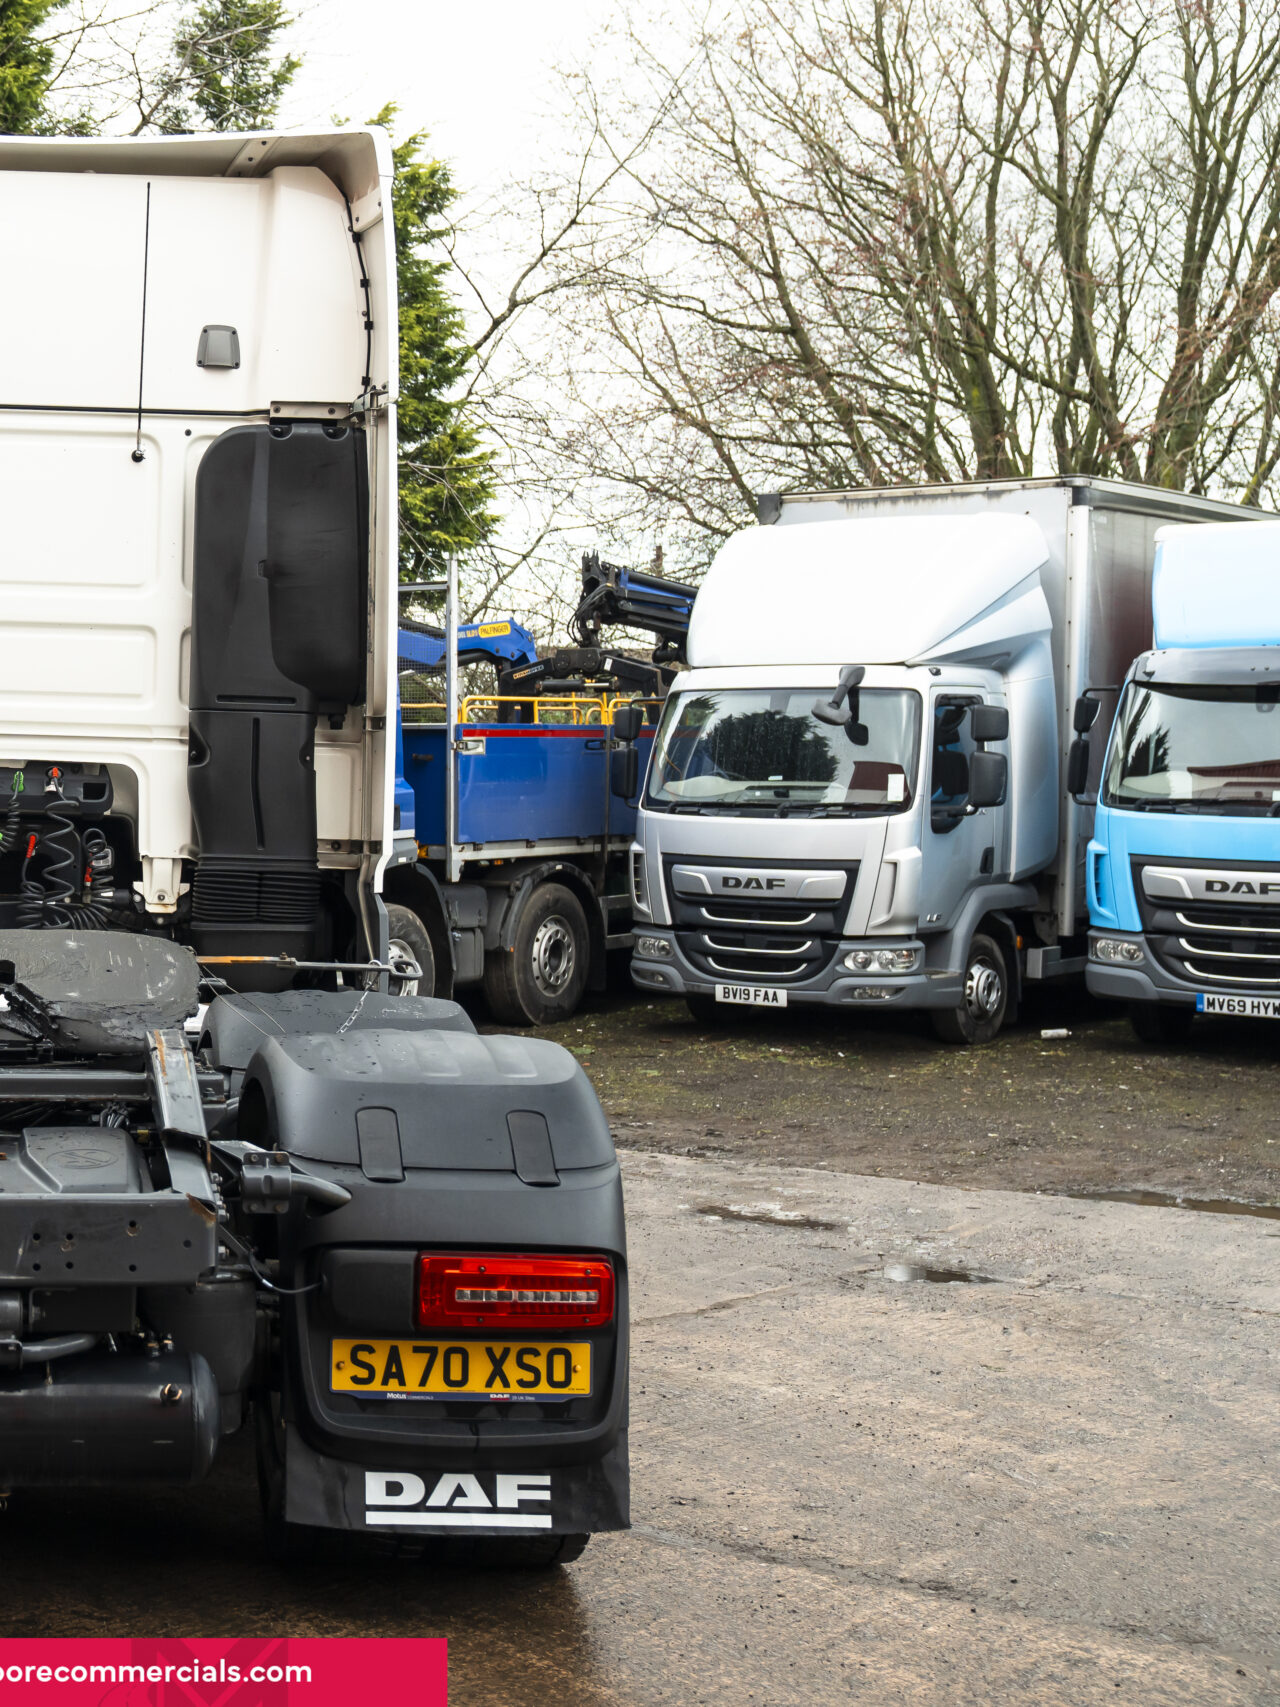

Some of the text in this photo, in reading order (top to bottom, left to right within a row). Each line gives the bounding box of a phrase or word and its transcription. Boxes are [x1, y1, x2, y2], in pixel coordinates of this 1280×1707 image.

[480, 624, 509, 635] PALFINGER
[722, 876, 786, 890] DAF
[1205, 880, 1280, 895] DAF
[723, 986, 779, 1003] BV19 FAA
[1206, 997, 1280, 1015] MV69 HYW
[349, 1344, 573, 1389] SA70 XSO
[365, 1471, 551, 1508] DAF
